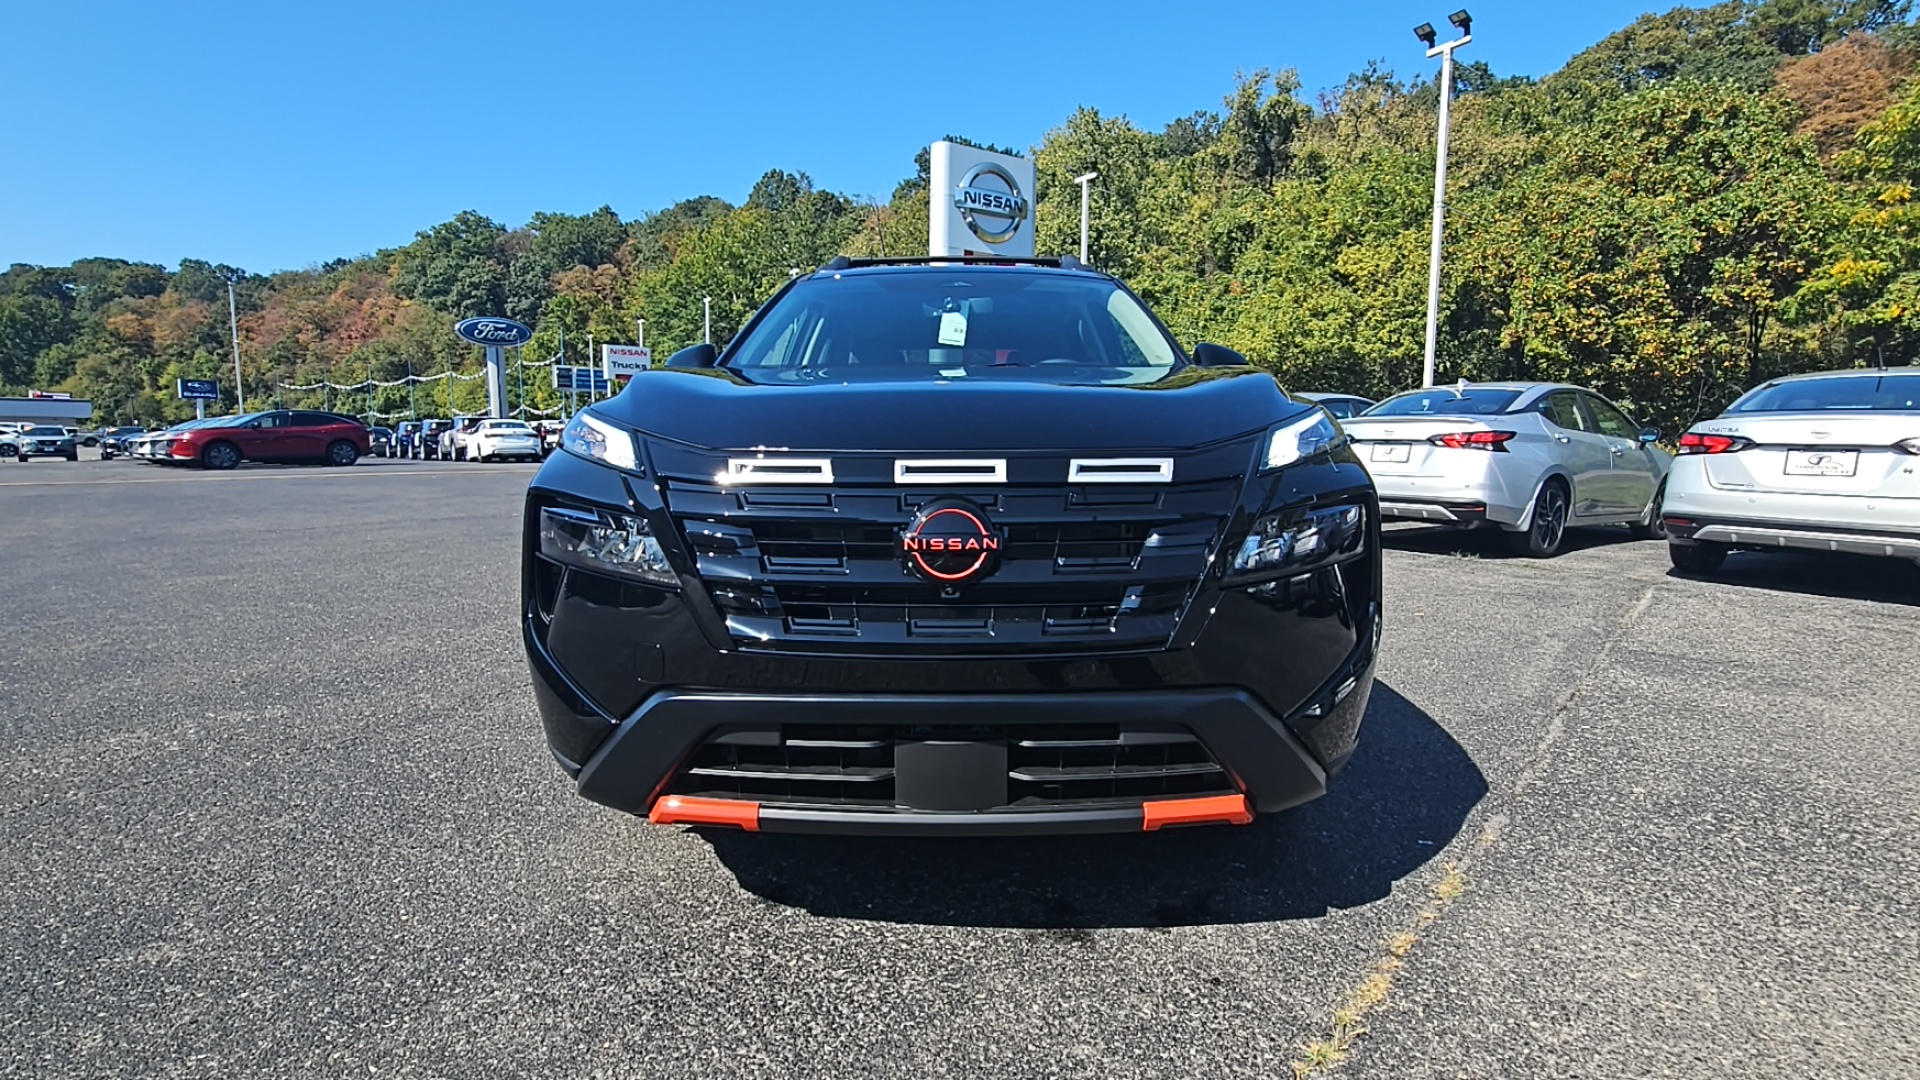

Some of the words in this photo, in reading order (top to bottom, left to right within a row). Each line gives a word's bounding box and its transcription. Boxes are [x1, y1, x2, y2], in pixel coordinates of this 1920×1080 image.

[963, 191, 1024, 213] NISSAN
[474, 321, 519, 340] Ford
[609, 348, 648, 357] NISSAN
[611, 361, 647, 371] Trucks
[903, 536, 998, 551] NISSAN
